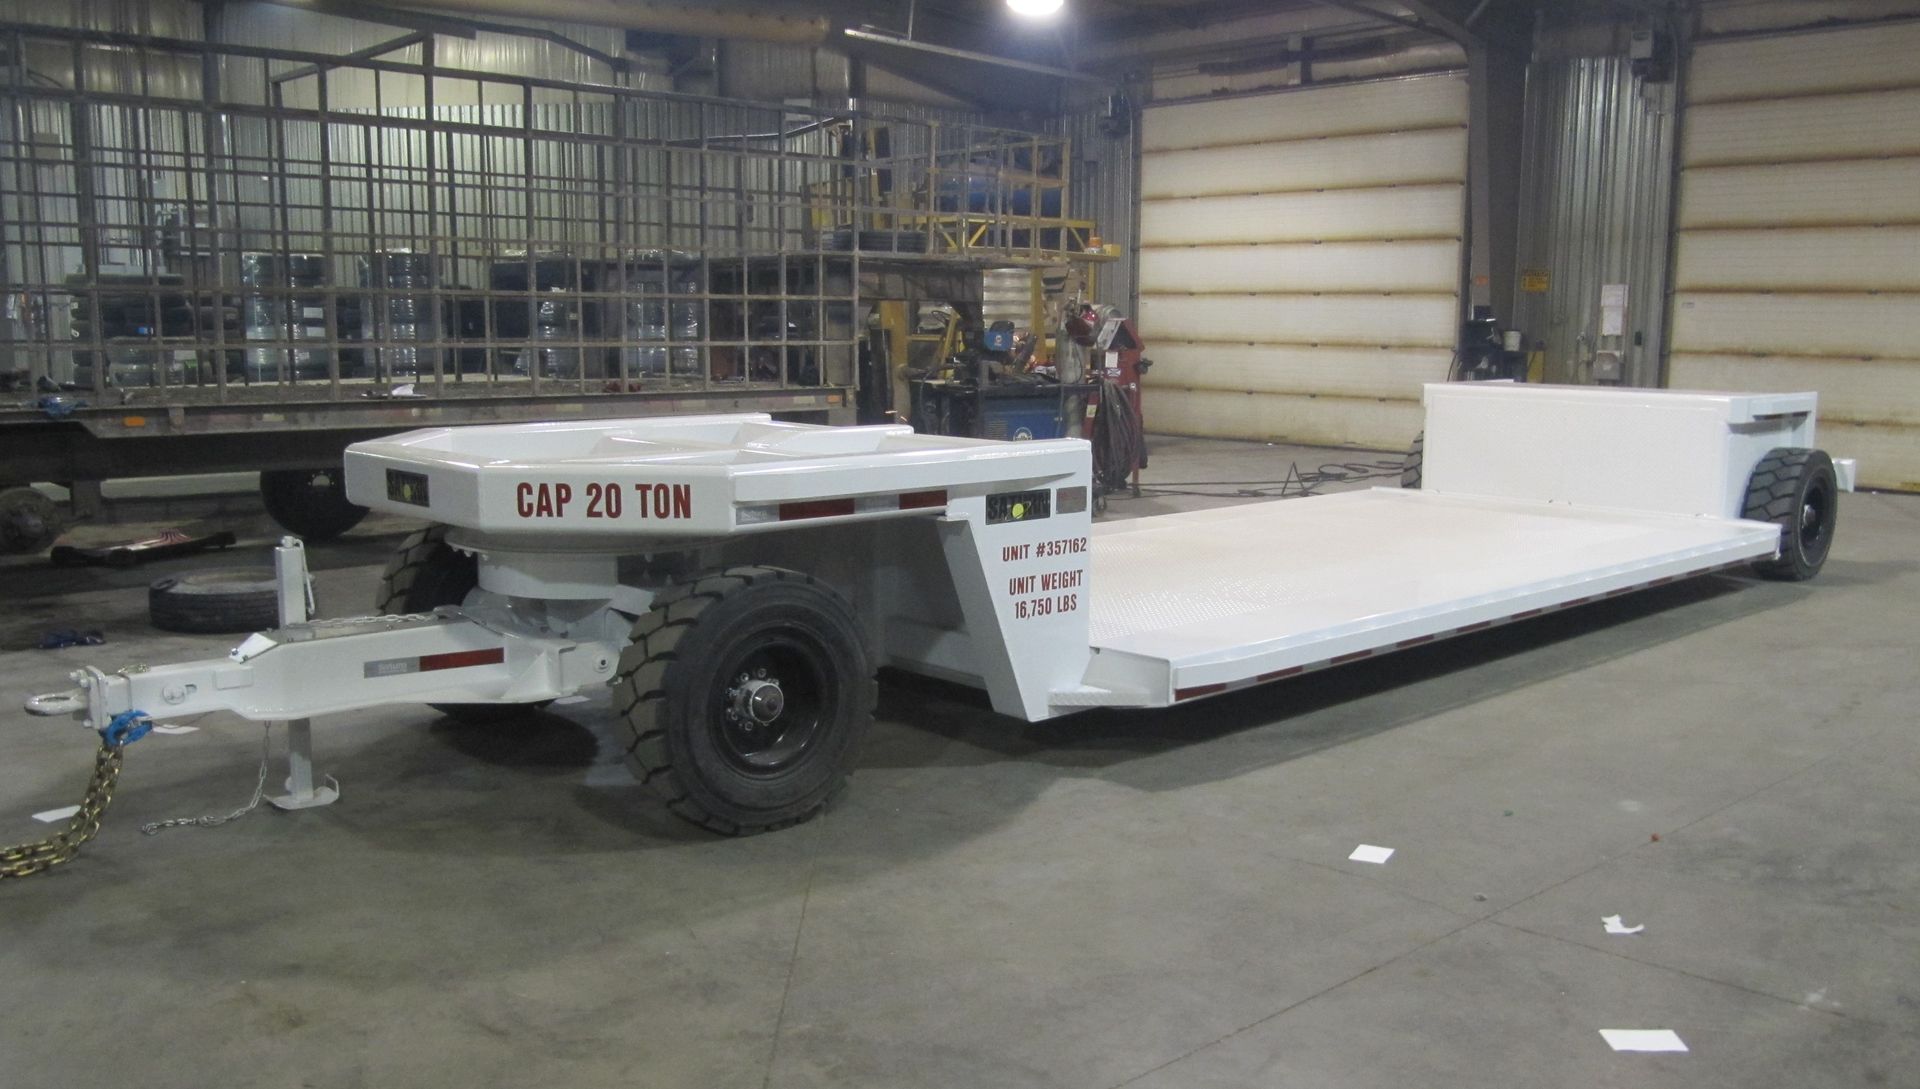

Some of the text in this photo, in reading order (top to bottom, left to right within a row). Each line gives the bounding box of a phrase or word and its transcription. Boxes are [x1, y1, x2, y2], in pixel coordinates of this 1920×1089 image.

[517, 482, 692, 519] CAP 20 TON
[1002, 537, 1087, 562] UNIT #357162
[1009, 569, 1083, 596] UNIT WEIGHT
[1015, 593, 1077, 620] 16,750 LBS
